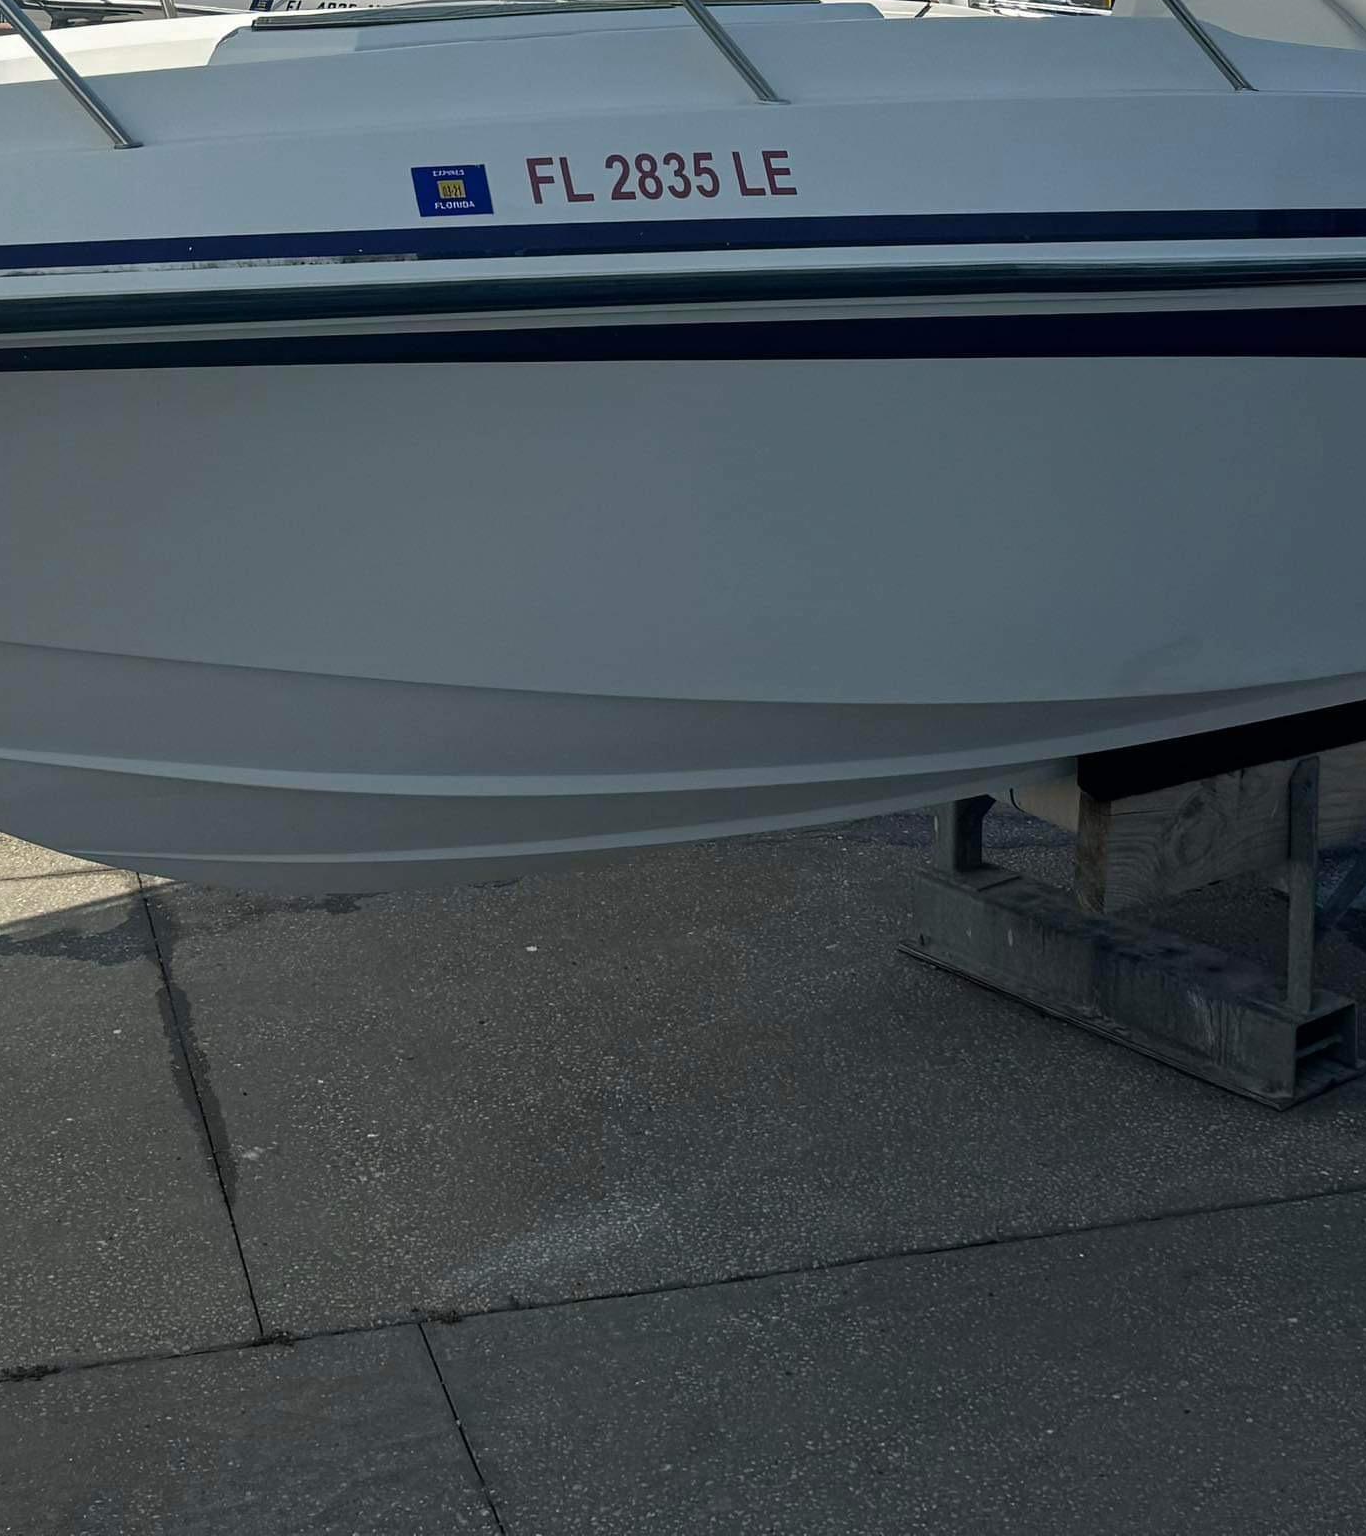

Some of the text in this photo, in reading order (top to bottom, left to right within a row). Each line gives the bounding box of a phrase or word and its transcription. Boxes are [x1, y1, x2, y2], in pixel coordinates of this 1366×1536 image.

[526, 149, 798, 204] FL 2835 LE
[434, 200, 475, 210] FLORIDA
